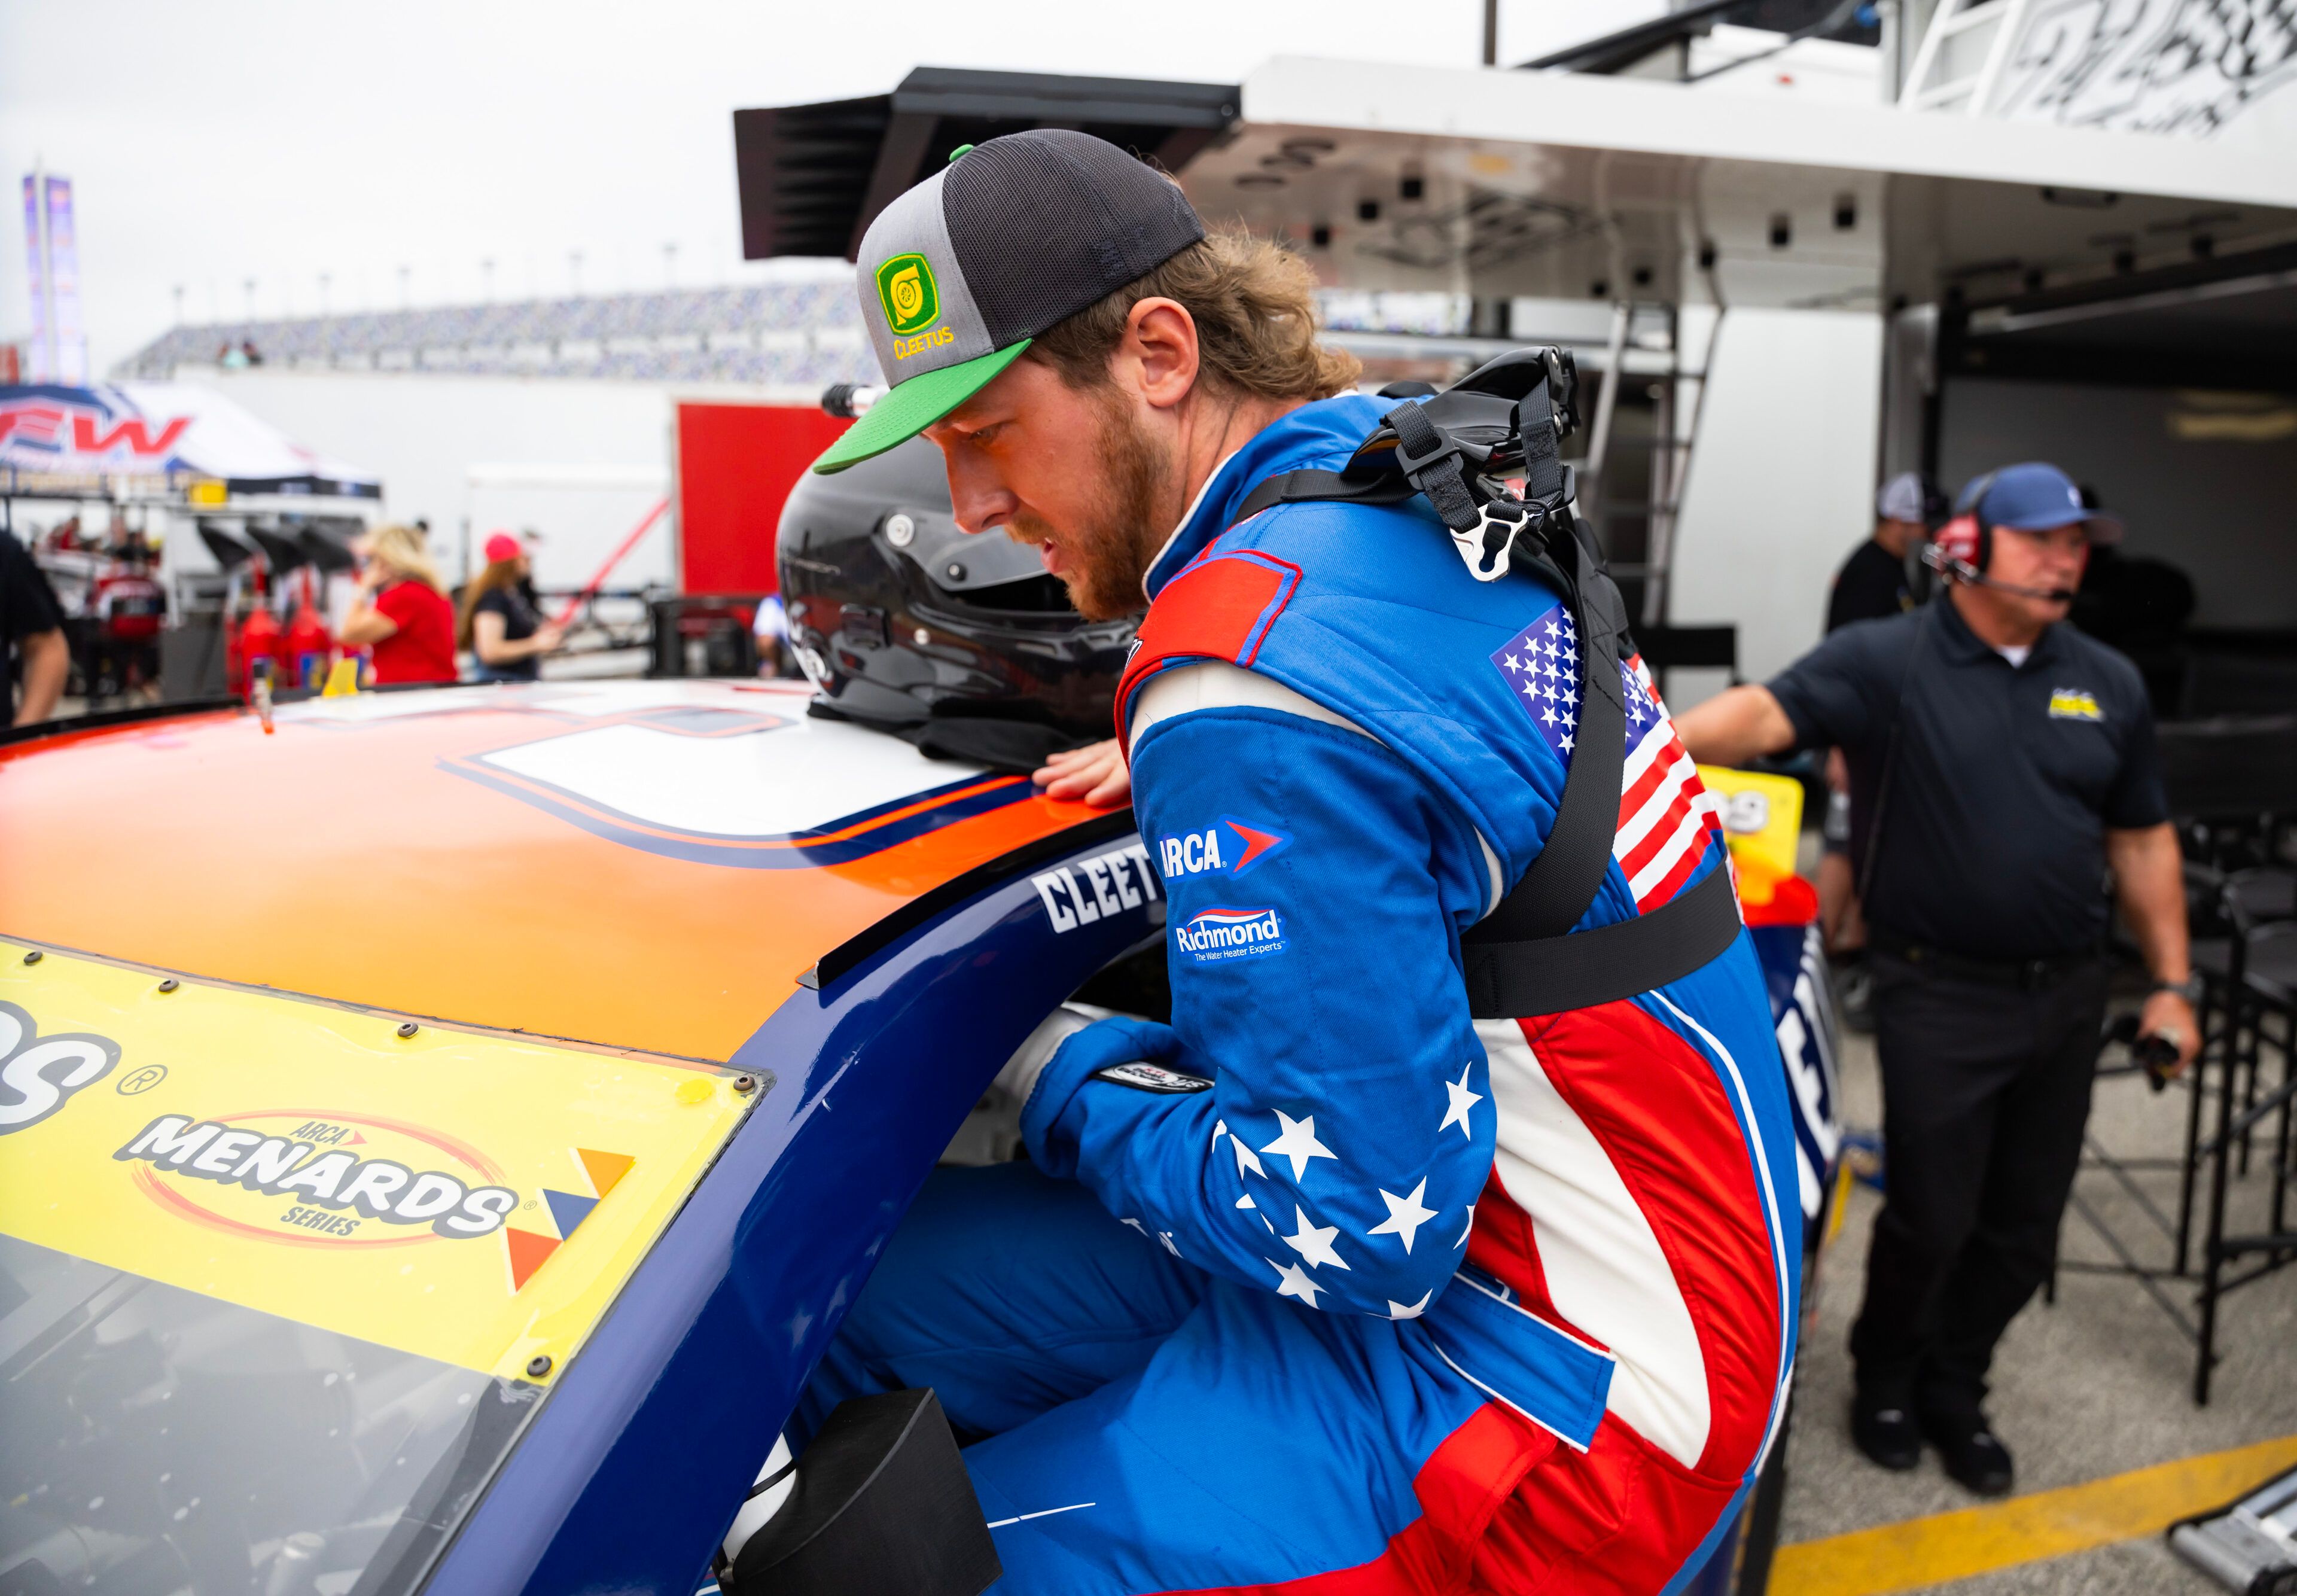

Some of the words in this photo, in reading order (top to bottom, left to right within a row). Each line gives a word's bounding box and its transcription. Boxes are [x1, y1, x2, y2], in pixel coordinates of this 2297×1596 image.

[894, 327, 954, 360] CLEETUS
[1176, 909, 1280, 952] Richmond
[1195, 953, 1206, 961] The
[1206, 952, 1222, 961] Water
[1223, 948, 1247, 958] Heater
[0, 1000, 122, 1136] S
[289, 1121, 349, 1145] ARCA
[112, 1114, 519, 1239] MENARDS
[280, 1207, 361, 1236] SERIES
